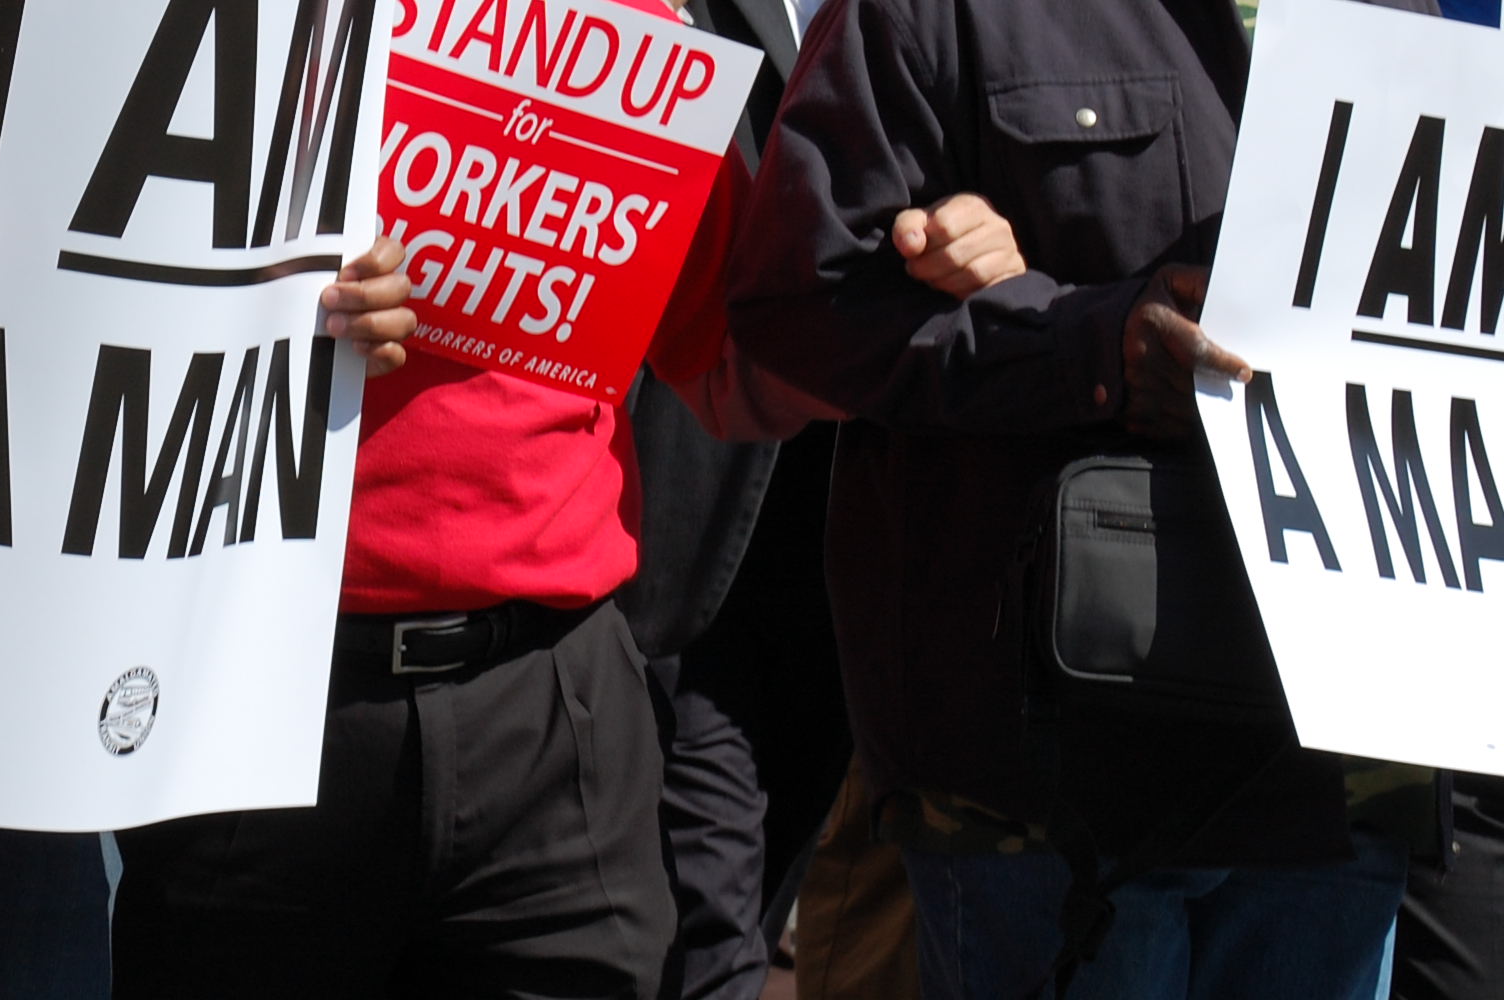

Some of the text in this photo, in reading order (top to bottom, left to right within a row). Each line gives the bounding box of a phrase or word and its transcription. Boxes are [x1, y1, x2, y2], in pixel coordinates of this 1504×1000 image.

[502, 98, 553, 146] for
[620, 33, 716, 127] UP
[1291, 98, 1354, 310] I
[376, 214, 596, 344] GHTS!
[413, 322, 598, 390] WORKERS OF AMERICA
[60, 334, 337, 562] MAN
[1244, 369, 1504, 594] A MA
